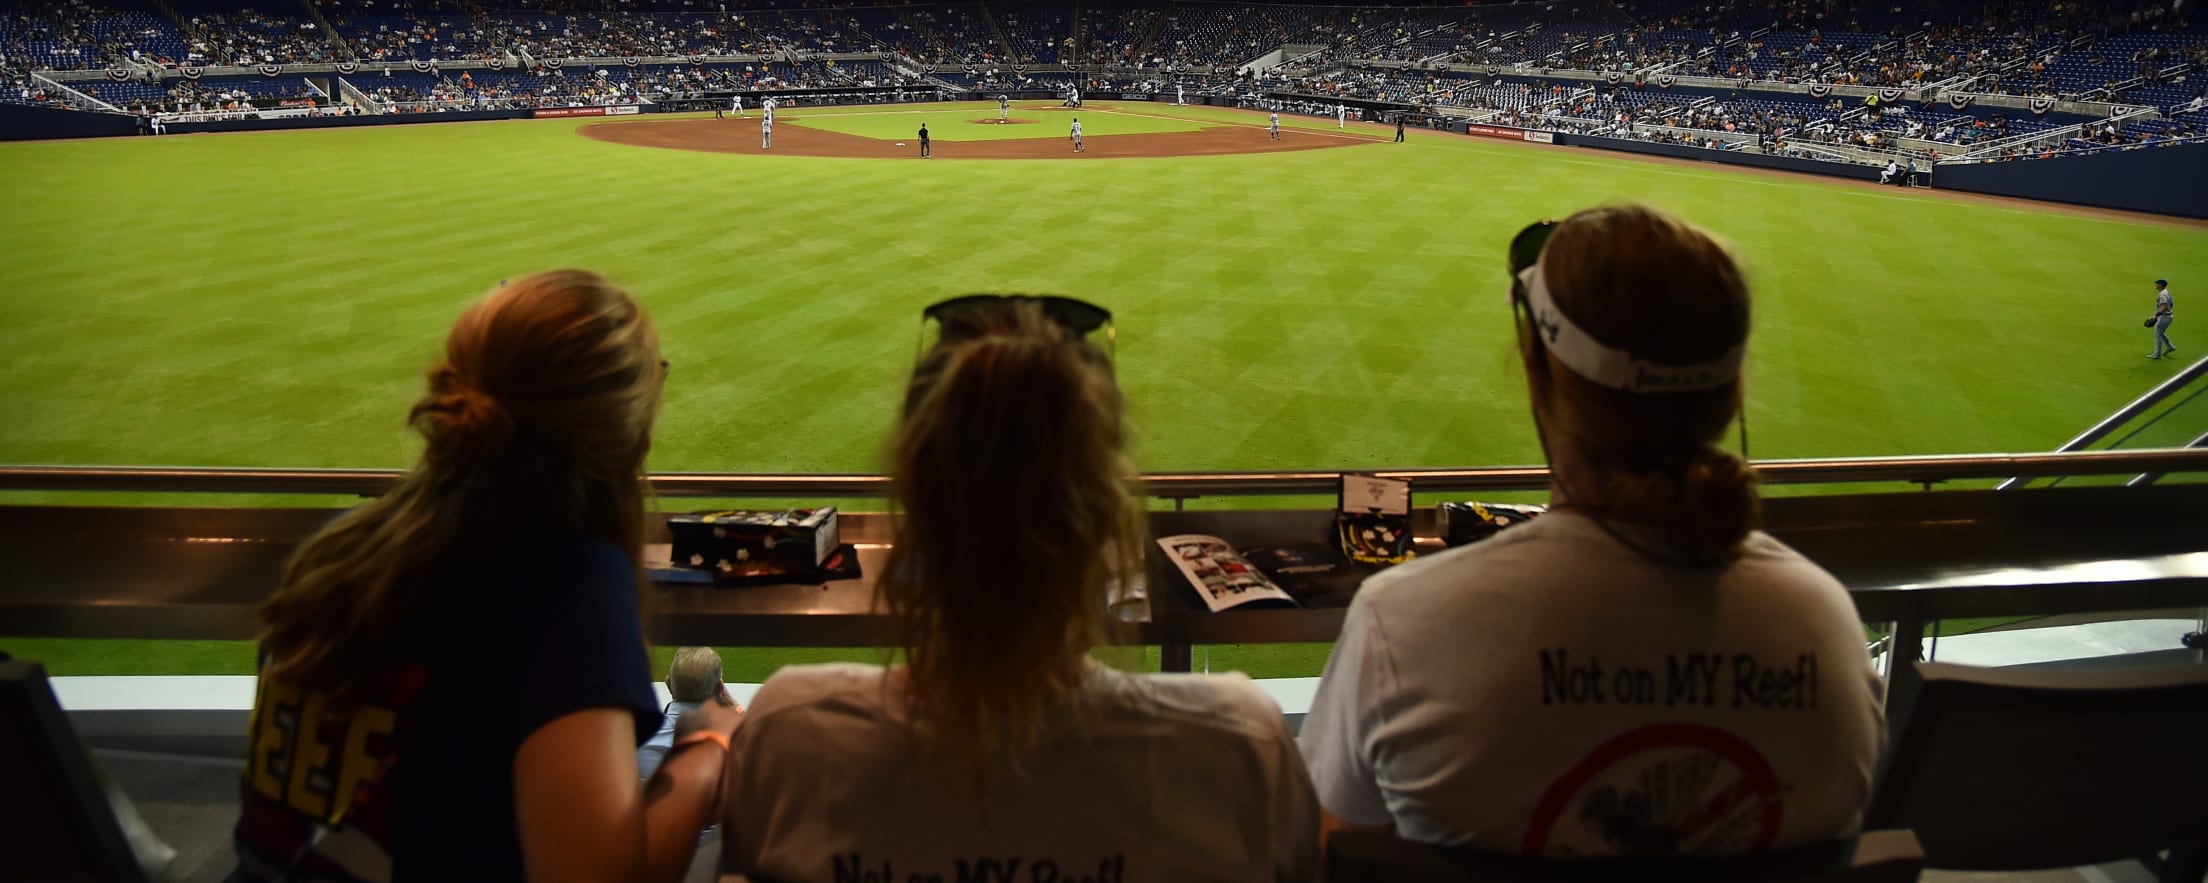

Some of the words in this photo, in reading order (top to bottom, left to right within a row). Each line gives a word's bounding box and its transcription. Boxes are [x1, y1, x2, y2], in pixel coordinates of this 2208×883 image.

[1538, 647, 1605, 706] Not
[1613, 667, 1656, 706] on
[1664, 652, 1722, 708] MY
[1730, 652, 1819, 710] Reef!
[243, 668, 397, 828] EEF
